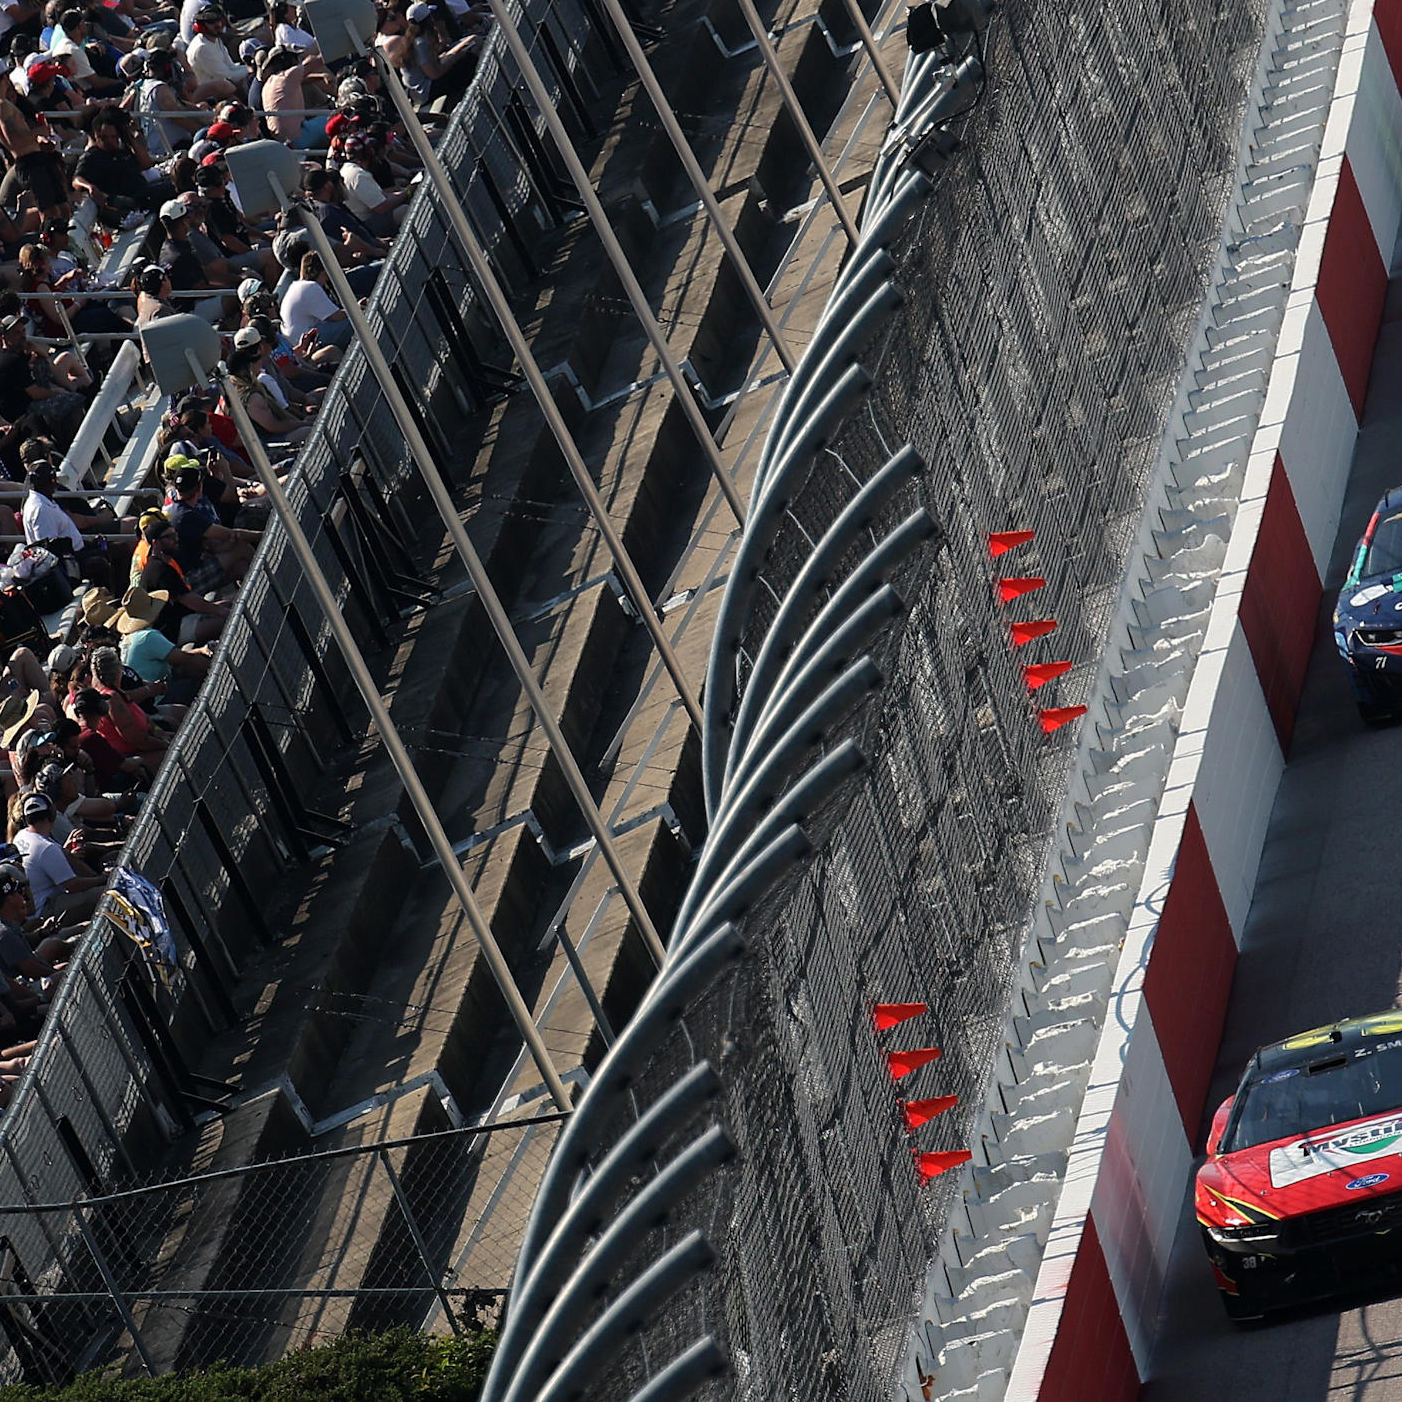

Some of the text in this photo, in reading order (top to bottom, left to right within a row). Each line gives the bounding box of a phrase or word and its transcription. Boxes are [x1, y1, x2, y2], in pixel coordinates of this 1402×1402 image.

[1375, 656, 1387, 670] 71
[1354, 1048, 1372, 1058] Z.
[1354, 1175, 1382, 1188] Ford
[1242, 1255, 1258, 1269] 38
